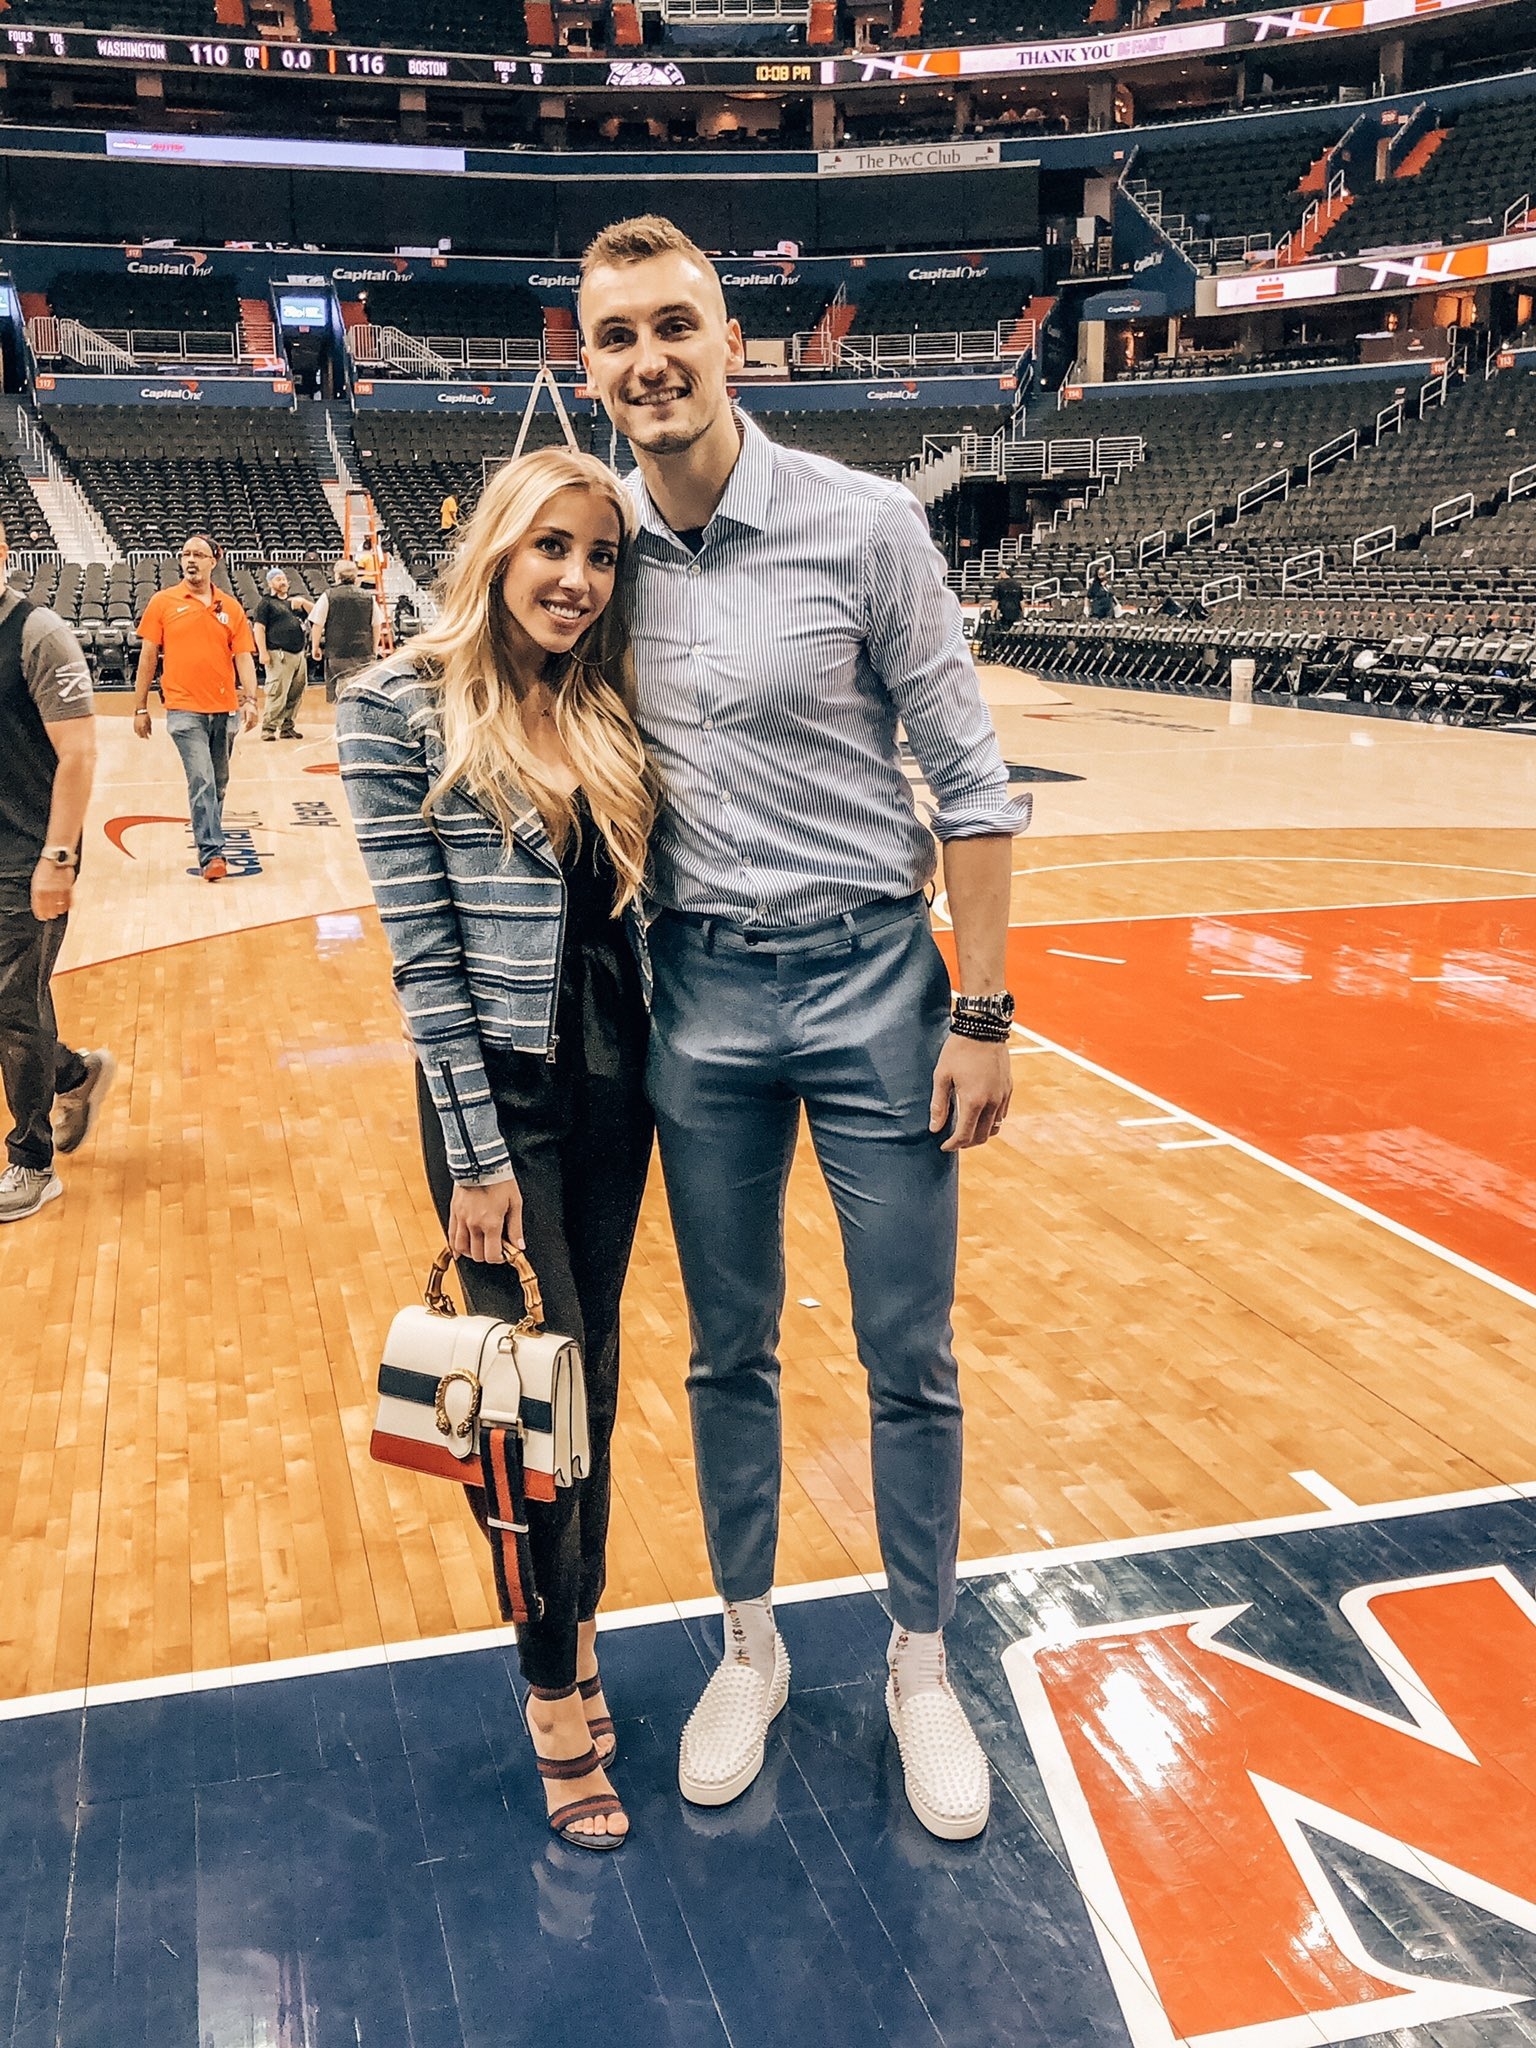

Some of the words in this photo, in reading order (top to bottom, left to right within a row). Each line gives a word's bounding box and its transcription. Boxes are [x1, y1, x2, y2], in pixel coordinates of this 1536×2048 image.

[8, 30, 33, 43] FOULS
[49, 32, 64, 45] TOL
[16, 42, 25, 55] 5
[97, 40, 167, 61] WASHINGTON
[189, 43, 229, 67] 110
[244, 46, 260, 59] QTR
[1017, 48, 1077, 65] THANK
[1081, 43, 1114, 61] YOU
[282, 49, 312, 69] 0.0
[346, 53, 385, 75] 116
[408, 59, 447, 76] BOSTON
[493, 61, 517, 73] FOULS
[500, 72, 509, 84] 5
[755, 65, 789, 81] 10:08
[792, 65, 811, 81] PM
[856, 154, 884, 169] The
[889, 152, 923, 167] PwC
[927, 149, 961, 165] Club
